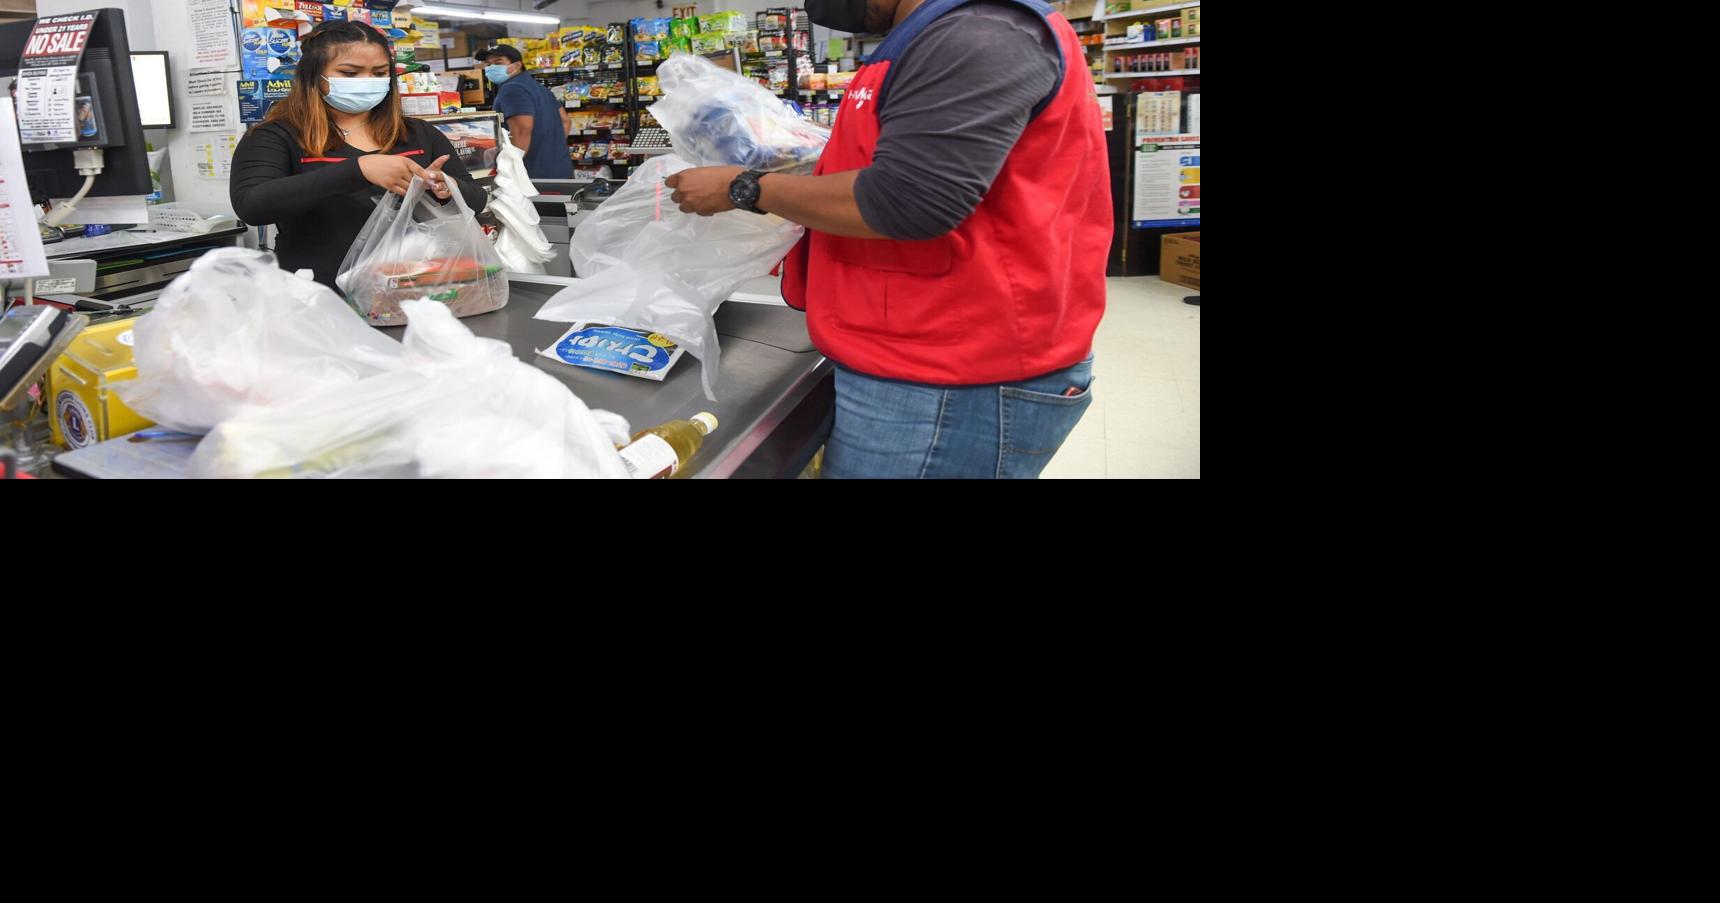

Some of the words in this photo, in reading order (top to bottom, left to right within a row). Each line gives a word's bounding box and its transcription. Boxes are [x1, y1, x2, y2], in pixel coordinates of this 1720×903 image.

[672, 6, 696, 18] EXIT
[52, 15, 80, 23] CHECK
[67, 23, 88, 31] YEARS
[25, 34, 50, 55] NO
[47, 31, 86, 54] SALE
[266, 80, 292, 88] Advil
[568, 335, 658, 363] 다시마
